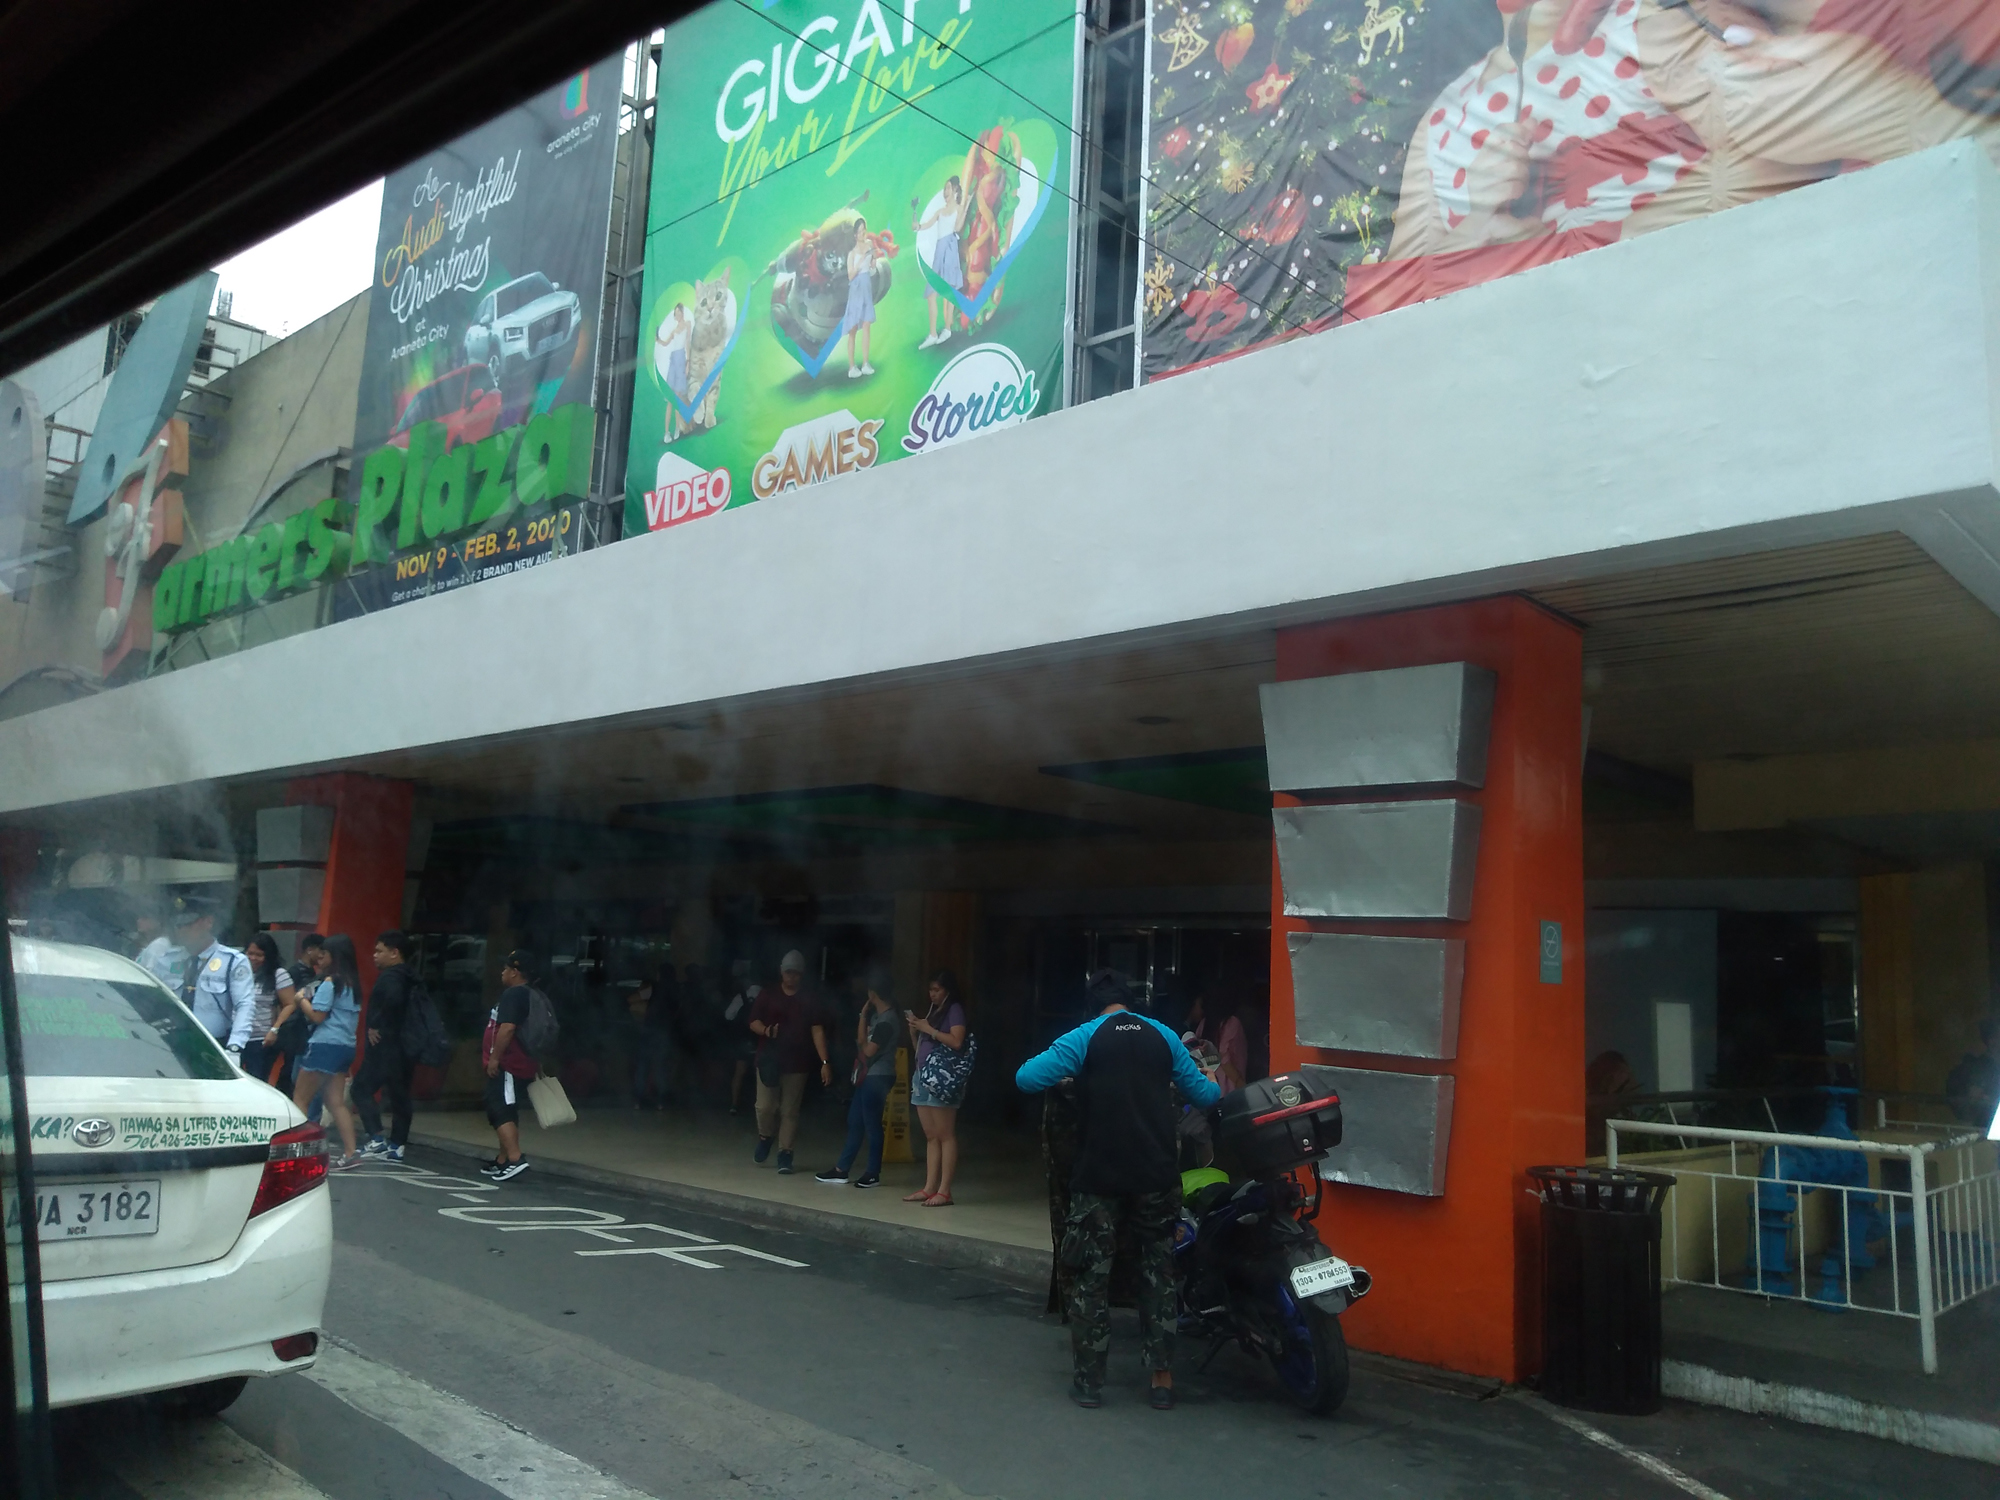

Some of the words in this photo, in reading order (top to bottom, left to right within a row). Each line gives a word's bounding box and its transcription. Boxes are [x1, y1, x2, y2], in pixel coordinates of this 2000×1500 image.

[715, 0, 972, 144] GIGA
[825, 18, 973, 178] Love
[390, 236, 491, 323] Christmas
[390, 334, 427, 361] Araneta
[428, 324, 449, 343] City
[903, 373, 1038, 450] Stories
[352, 402, 576, 566] Plaza
[753, 420, 883, 498] GAMES
[645, 468, 730, 527] VIDEO
[396, 551, 430, 581] NOV
[436, 547, 447, 569] 9
[464, 532, 501, 562] FEB.
[506, 527, 521, 551] 2,
[483, 562, 513, 579] BRAND
[514, 556, 535, 571] NEW
[120, 1117, 162, 1134] ITAWAG
[165, 1117, 180, 1132] SA
[184, 1117, 217, 1133] LTFRB
[77, 1190, 151, 1223] 3182
